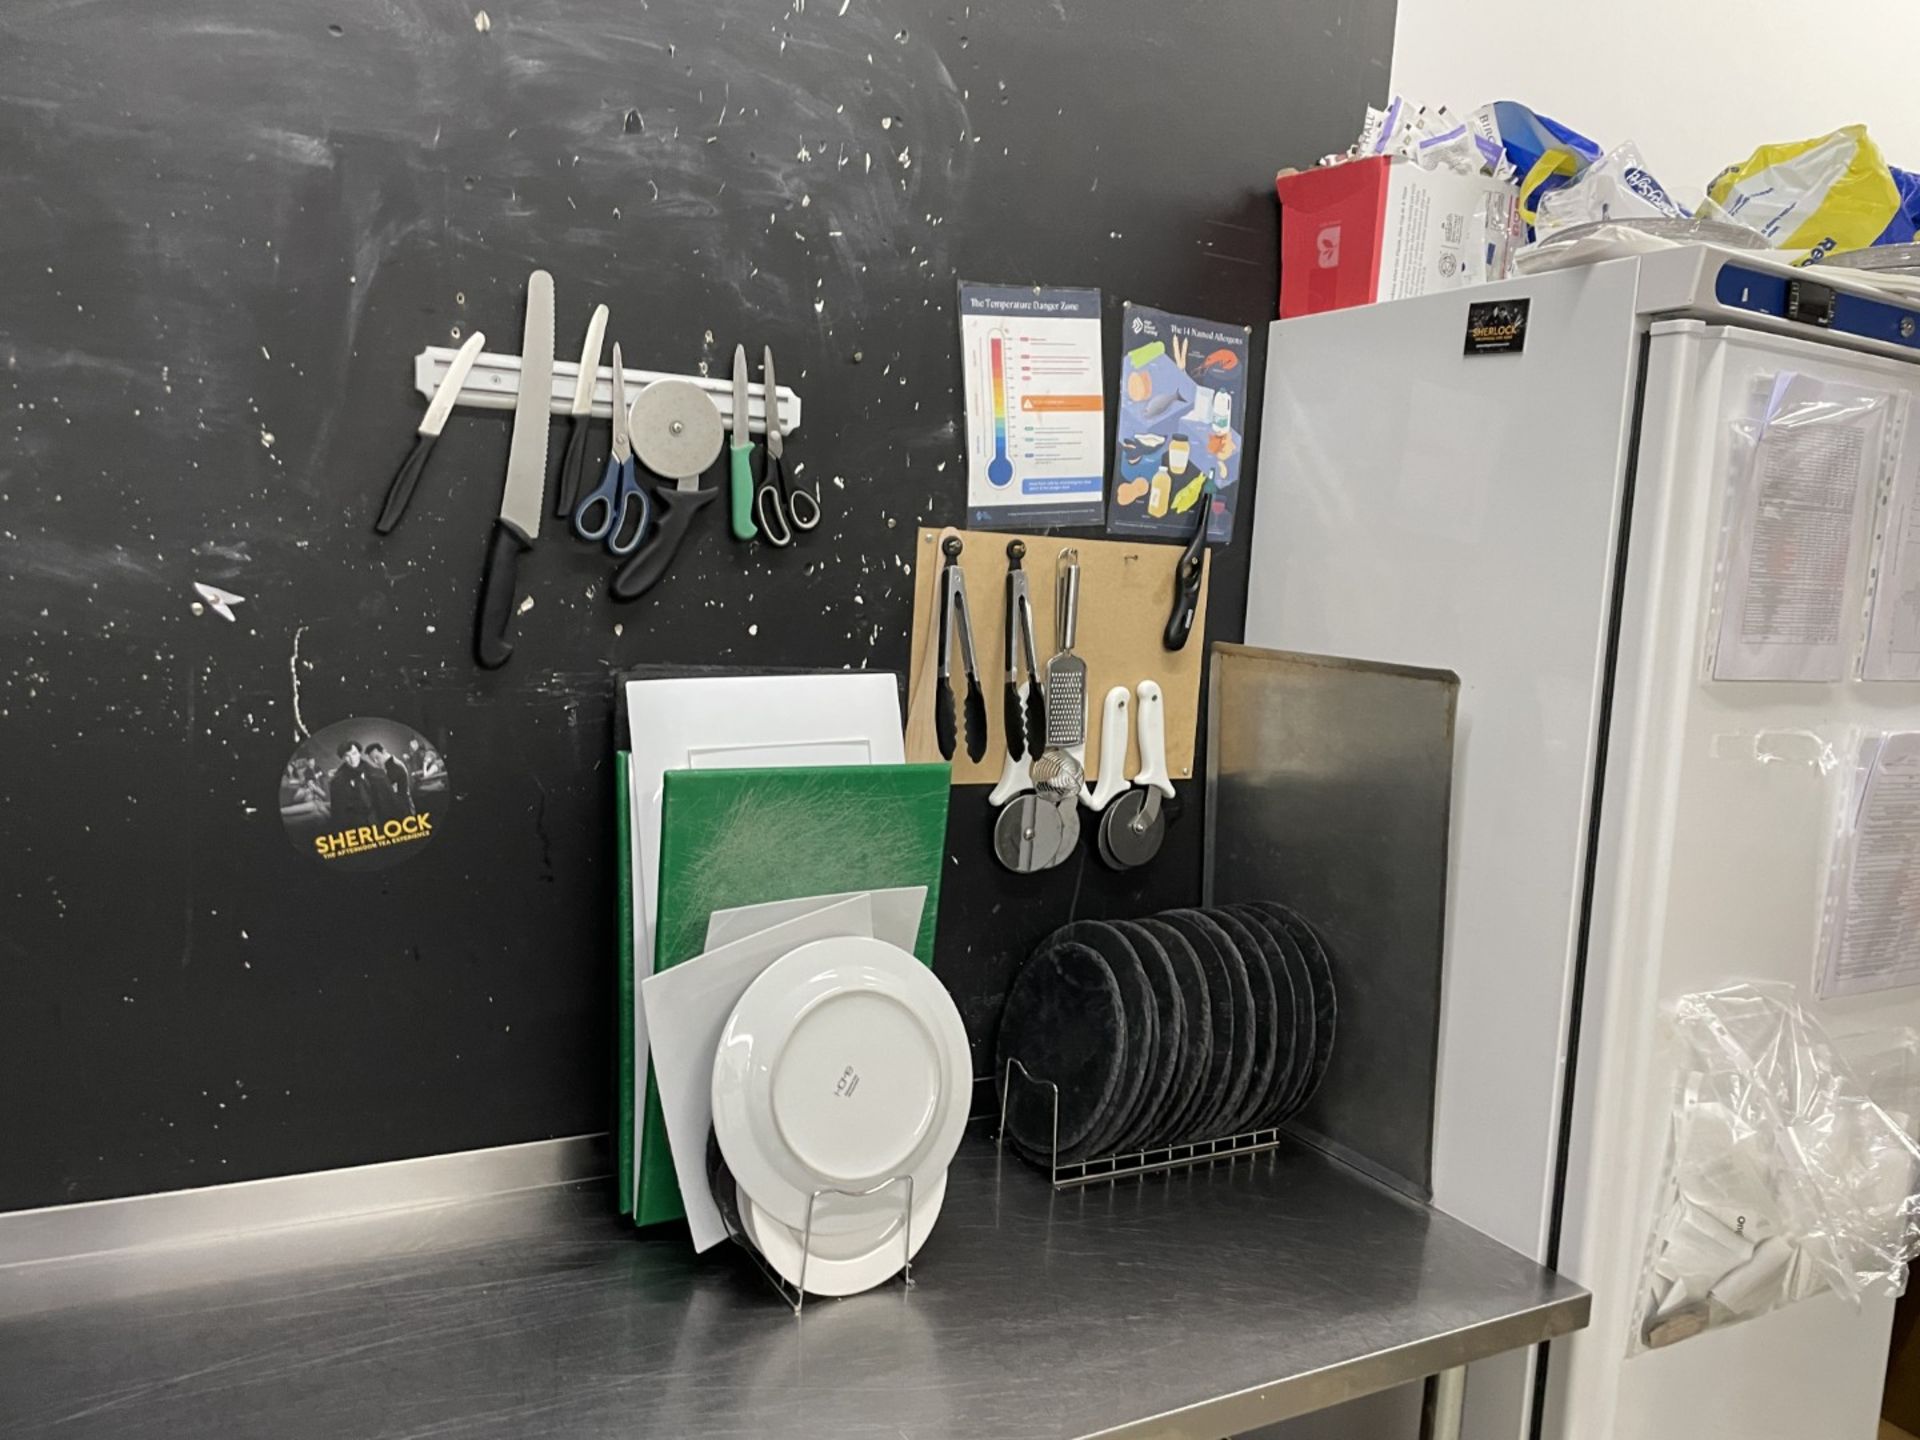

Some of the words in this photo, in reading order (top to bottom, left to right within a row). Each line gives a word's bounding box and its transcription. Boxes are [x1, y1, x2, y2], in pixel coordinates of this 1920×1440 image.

[969, 297, 985, 308] The
[985, 298, 1032, 311] Temperature
[1032, 301, 1060, 312] Danger
[1060, 301, 1080, 312] Zone
[1170, 324, 1183, 335] The
[1191, 327, 1214, 341] Named
[1472, 325, 1517, 337] SHERLOCK
[315, 812, 432, 854] SHERLOCK
[323, 851, 337, 860] THE
[378, 838, 392, 849] TEA
